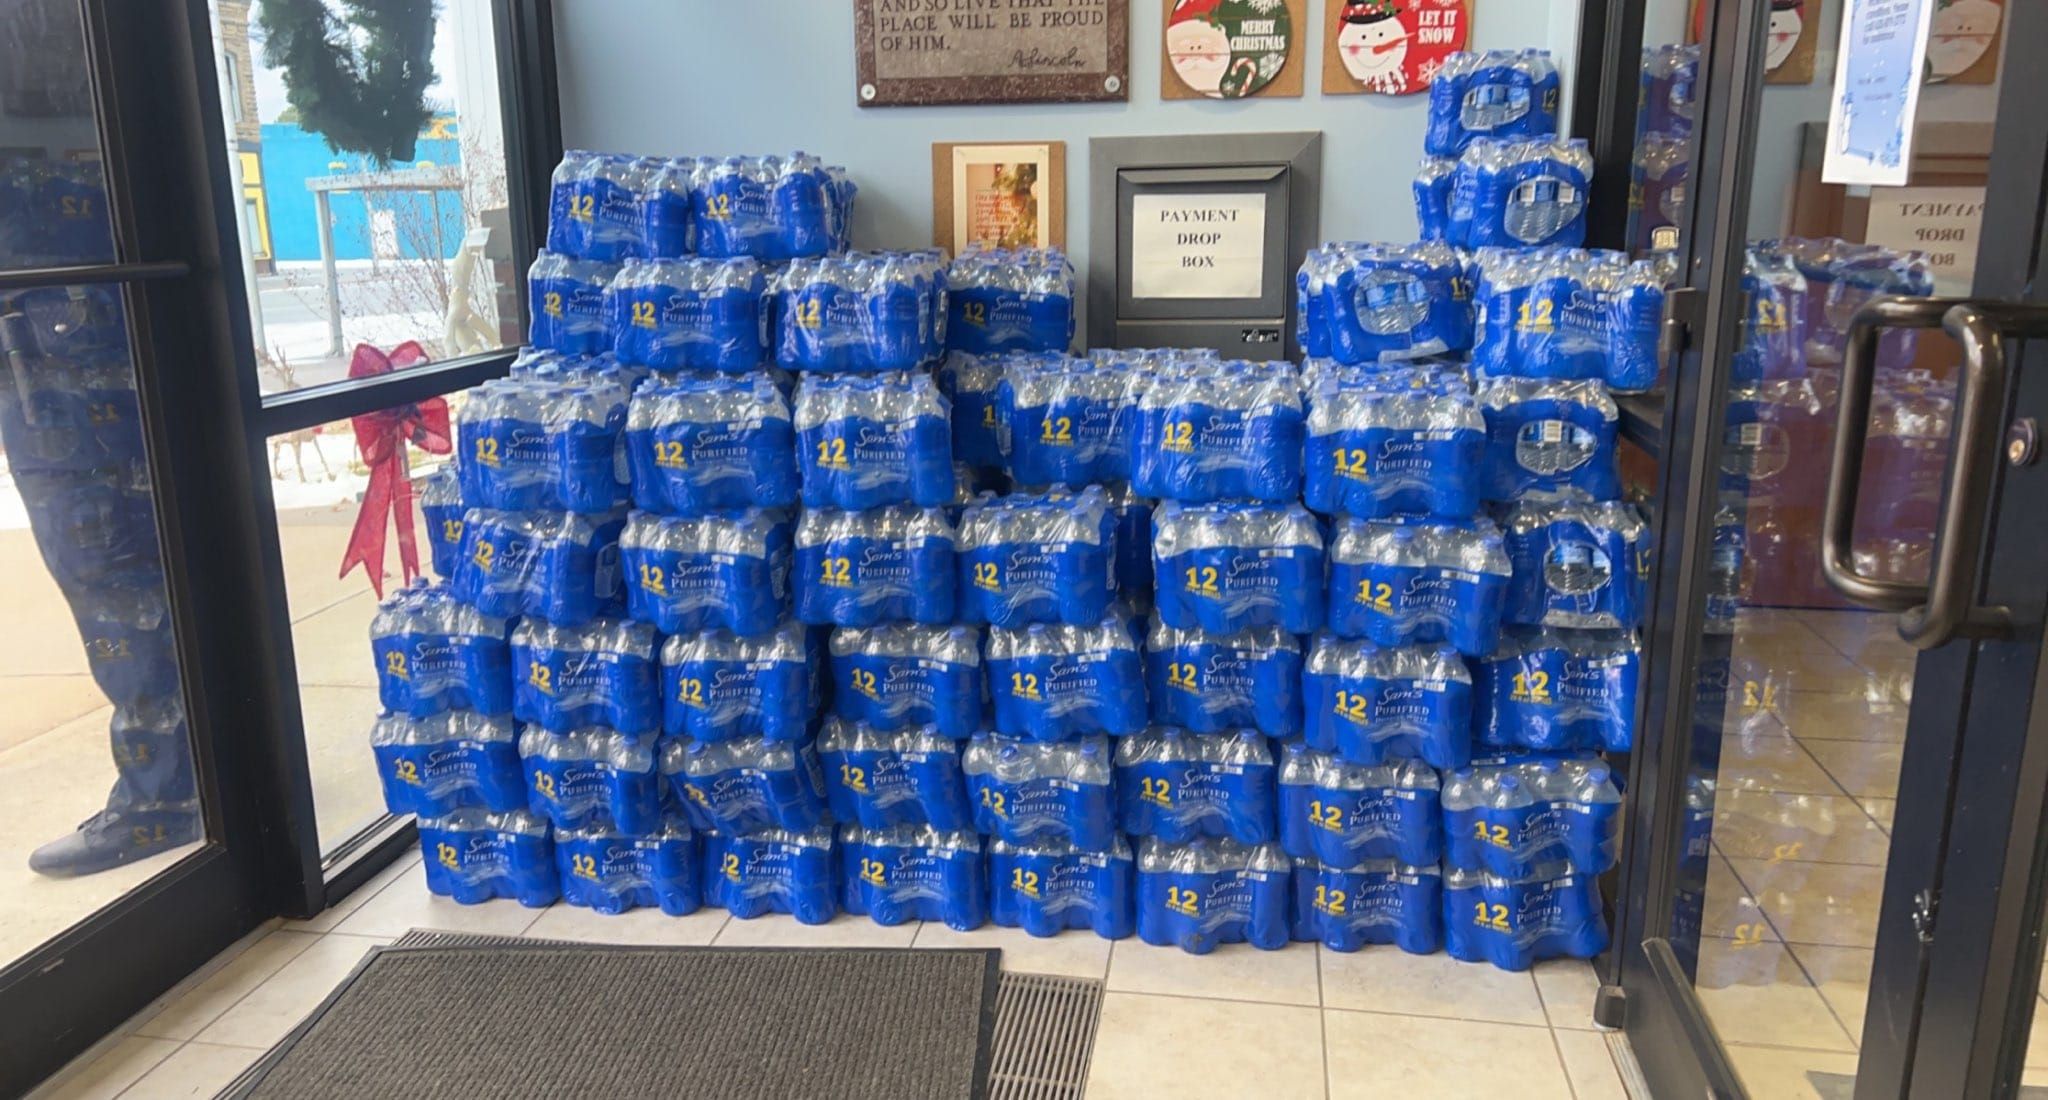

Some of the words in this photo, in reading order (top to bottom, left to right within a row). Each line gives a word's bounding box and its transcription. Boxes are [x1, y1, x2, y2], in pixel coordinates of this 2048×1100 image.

[881, 16, 937, 32] PLACE
[949, 14, 995, 30] WILL
[1010, 12, 1031, 28] BE
[1040, 11, 1103, 27] PROUD
[1241, 20, 1276, 35] MERRY
[1418, 11, 1440, 26] LET
[1442, 10, 1457, 25] IT
[881, 36, 901, 51] OF
[910, 36, 951, 51] HIM.
[1230, 36, 1285, 51] CHRISTMAS
[1418, 27, 1454, 44] SNOW
[571, 196, 594, 217] 12
[707, 195, 728, 217] 12
[1161, 209, 1240, 222] PAYMENT
[1177, 233, 1221, 245] DROP
[1182, 256, 1214, 267] BOX
[544, 293, 561, 315] 12
[632, 303, 656, 323] 12
[797, 299, 819, 322] 12
[964, 302, 985, 322] 12
[1518, 300, 1553, 325] 12
[1042, 417, 1071, 440] 12
[1163, 422, 1193, 443] 12
[476, 437, 498, 460] 12
[655, 442, 685, 463] 12
[817, 438, 847, 463] 12
[854, 446, 906, 460] PURIFIED
[1378, 437, 1424, 460] Sam's
[1333, 449, 1368, 474] 12
[1376, 459, 1432, 473] PURIFIED
[474, 540, 494, 567] 12
[858, 546, 902, 567] Sam's
[821, 557, 851, 582] 12
[858, 566, 911, 579] PURIFIED
[974, 562, 999, 587] 12
[1005, 570, 1057, 582] PURIFIED
[1226, 555, 1271, 577] Sam's
[640, 565, 665, 589] 12
[1185, 566, 1218, 592] 12
[1225, 575, 1278, 589] PURIFIED
[1403, 574, 1451, 596] Sam's
[1358, 579, 1393, 608] 12
[1399, 594, 1457, 608] PURIFIED
[386, 651, 407, 674] 12
[883, 664, 928, 682] Sam's
[1045, 662, 1088, 681] Sam's
[1205, 654, 1247, 674] Sam's
[1558, 660, 1600, 681] Sam's
[530, 662, 551, 689] 12
[851, 668, 876, 693] 12
[1011, 672, 1038, 695] 12
[1044, 678, 1097, 693] PURIFIED
[1168, 663, 1196, 687] 12
[1203, 674, 1254, 687] PURIFIED
[1511, 671, 1550, 698] 12
[679, 678, 703, 701] 12
[883, 681, 935, 694] PURIFIED
[1378, 687, 1424, 706] Sam's
[1556, 681, 1610, 699] PURIFIED
[1335, 690, 1367, 719] 12
[1374, 704, 1430, 718] PURIFIED
[394, 758, 417, 782] 12
[840, 764, 865, 788] 12
[1179, 769, 1221, 788] Sam's
[535, 770, 555, 794] 12
[1141, 777, 1170, 801] 12
[981, 787, 1005, 812] 12
[1013, 785, 1058, 803] Sam's
[1178, 788, 1230, 801] PURIFIED
[1011, 803, 1066, 816] PURIFIED
[1309, 800, 1343, 828] 12
[1475, 820, 1510, 846] 12
[437, 842, 458, 866] 12
[572, 854, 597, 877] 12
[860, 858, 885, 883] 12
[1047, 863, 1088, 882] Sam's
[1012, 868, 1038, 893] 12
[1045, 880, 1095, 893] PURIFIED
[1206, 879, 1245, 899] Sam's
[1167, 885, 1198, 911] 12
[1204, 896, 1252, 910] PURIFIED
[1315, 885, 1346, 912] 12
[1352, 898, 1403, 911] PURIFIED
[1475, 902, 1510, 928] 12
